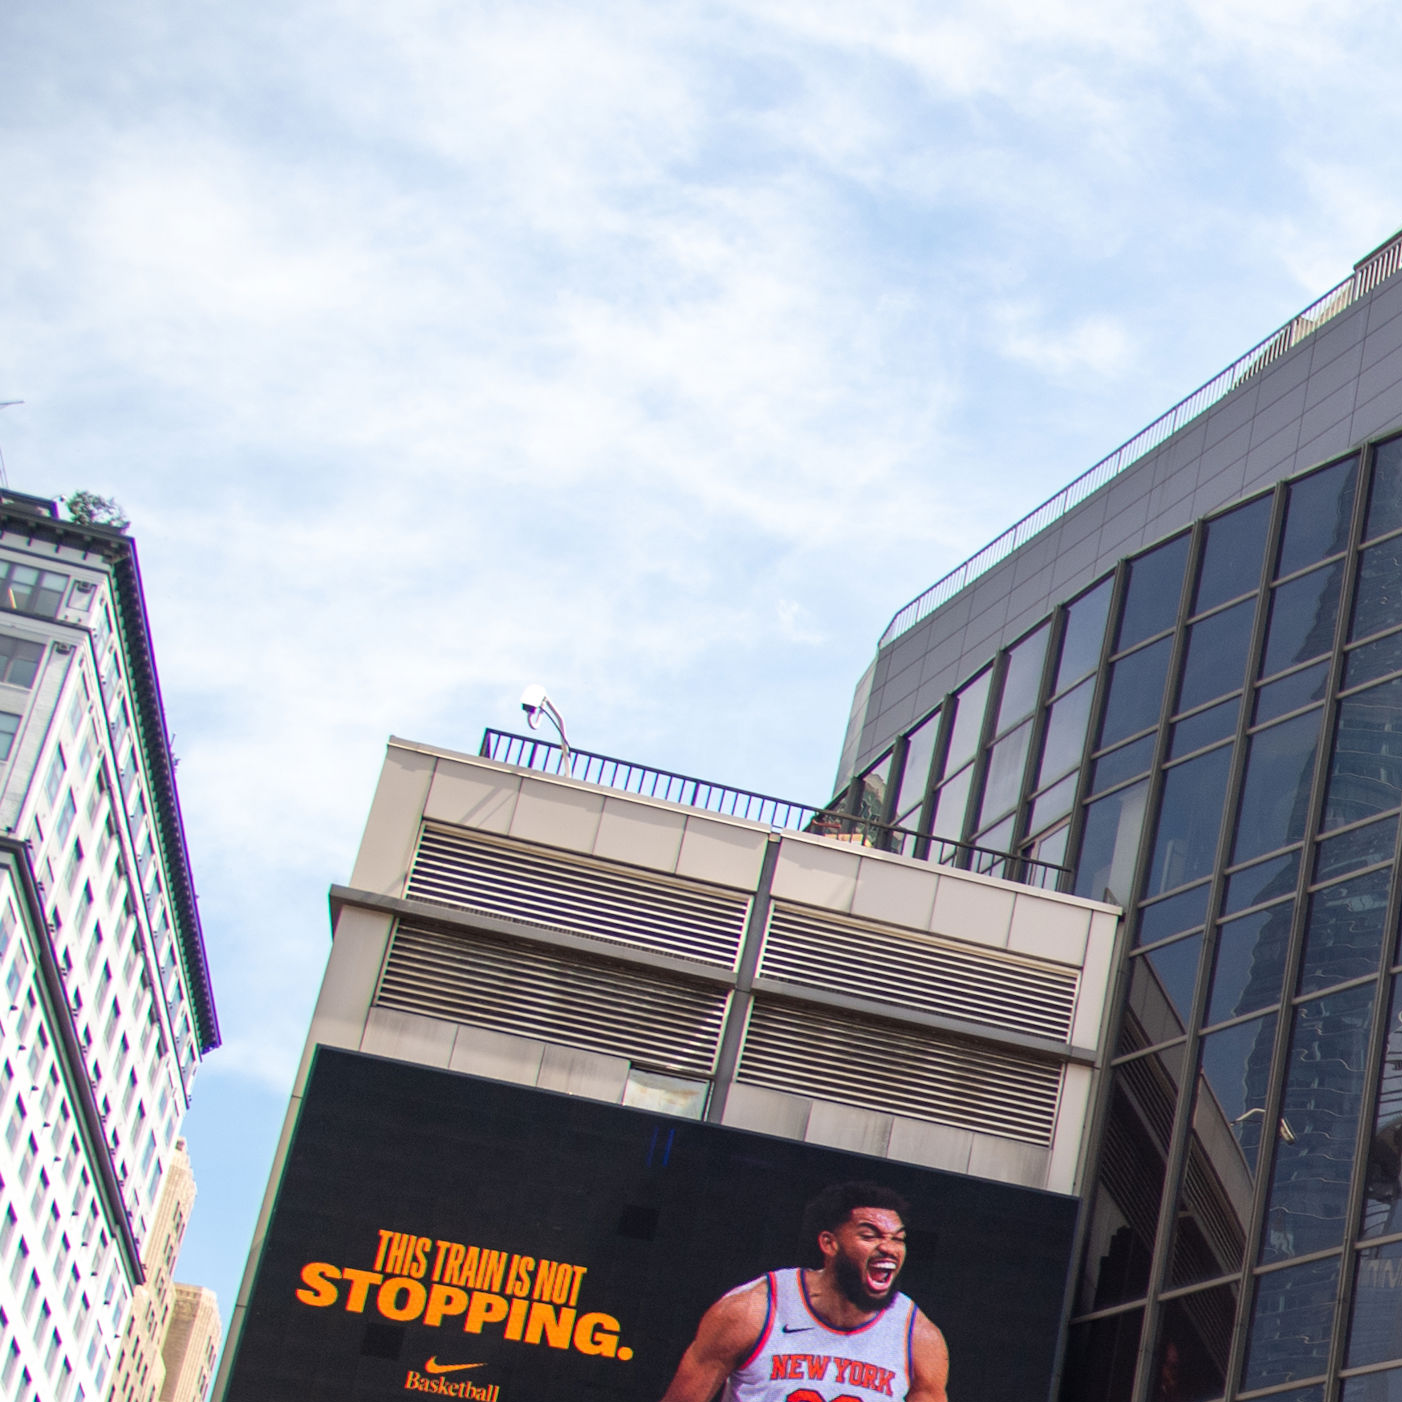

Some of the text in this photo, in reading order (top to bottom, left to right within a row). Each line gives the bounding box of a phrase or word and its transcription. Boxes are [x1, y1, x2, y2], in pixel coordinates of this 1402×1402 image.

[373, 1229, 588, 1307] THIS TRAIN IS NOT
[296, 1262, 634, 1361] STOPPING.
[770, 1353, 896, 1397] NEW YORK
